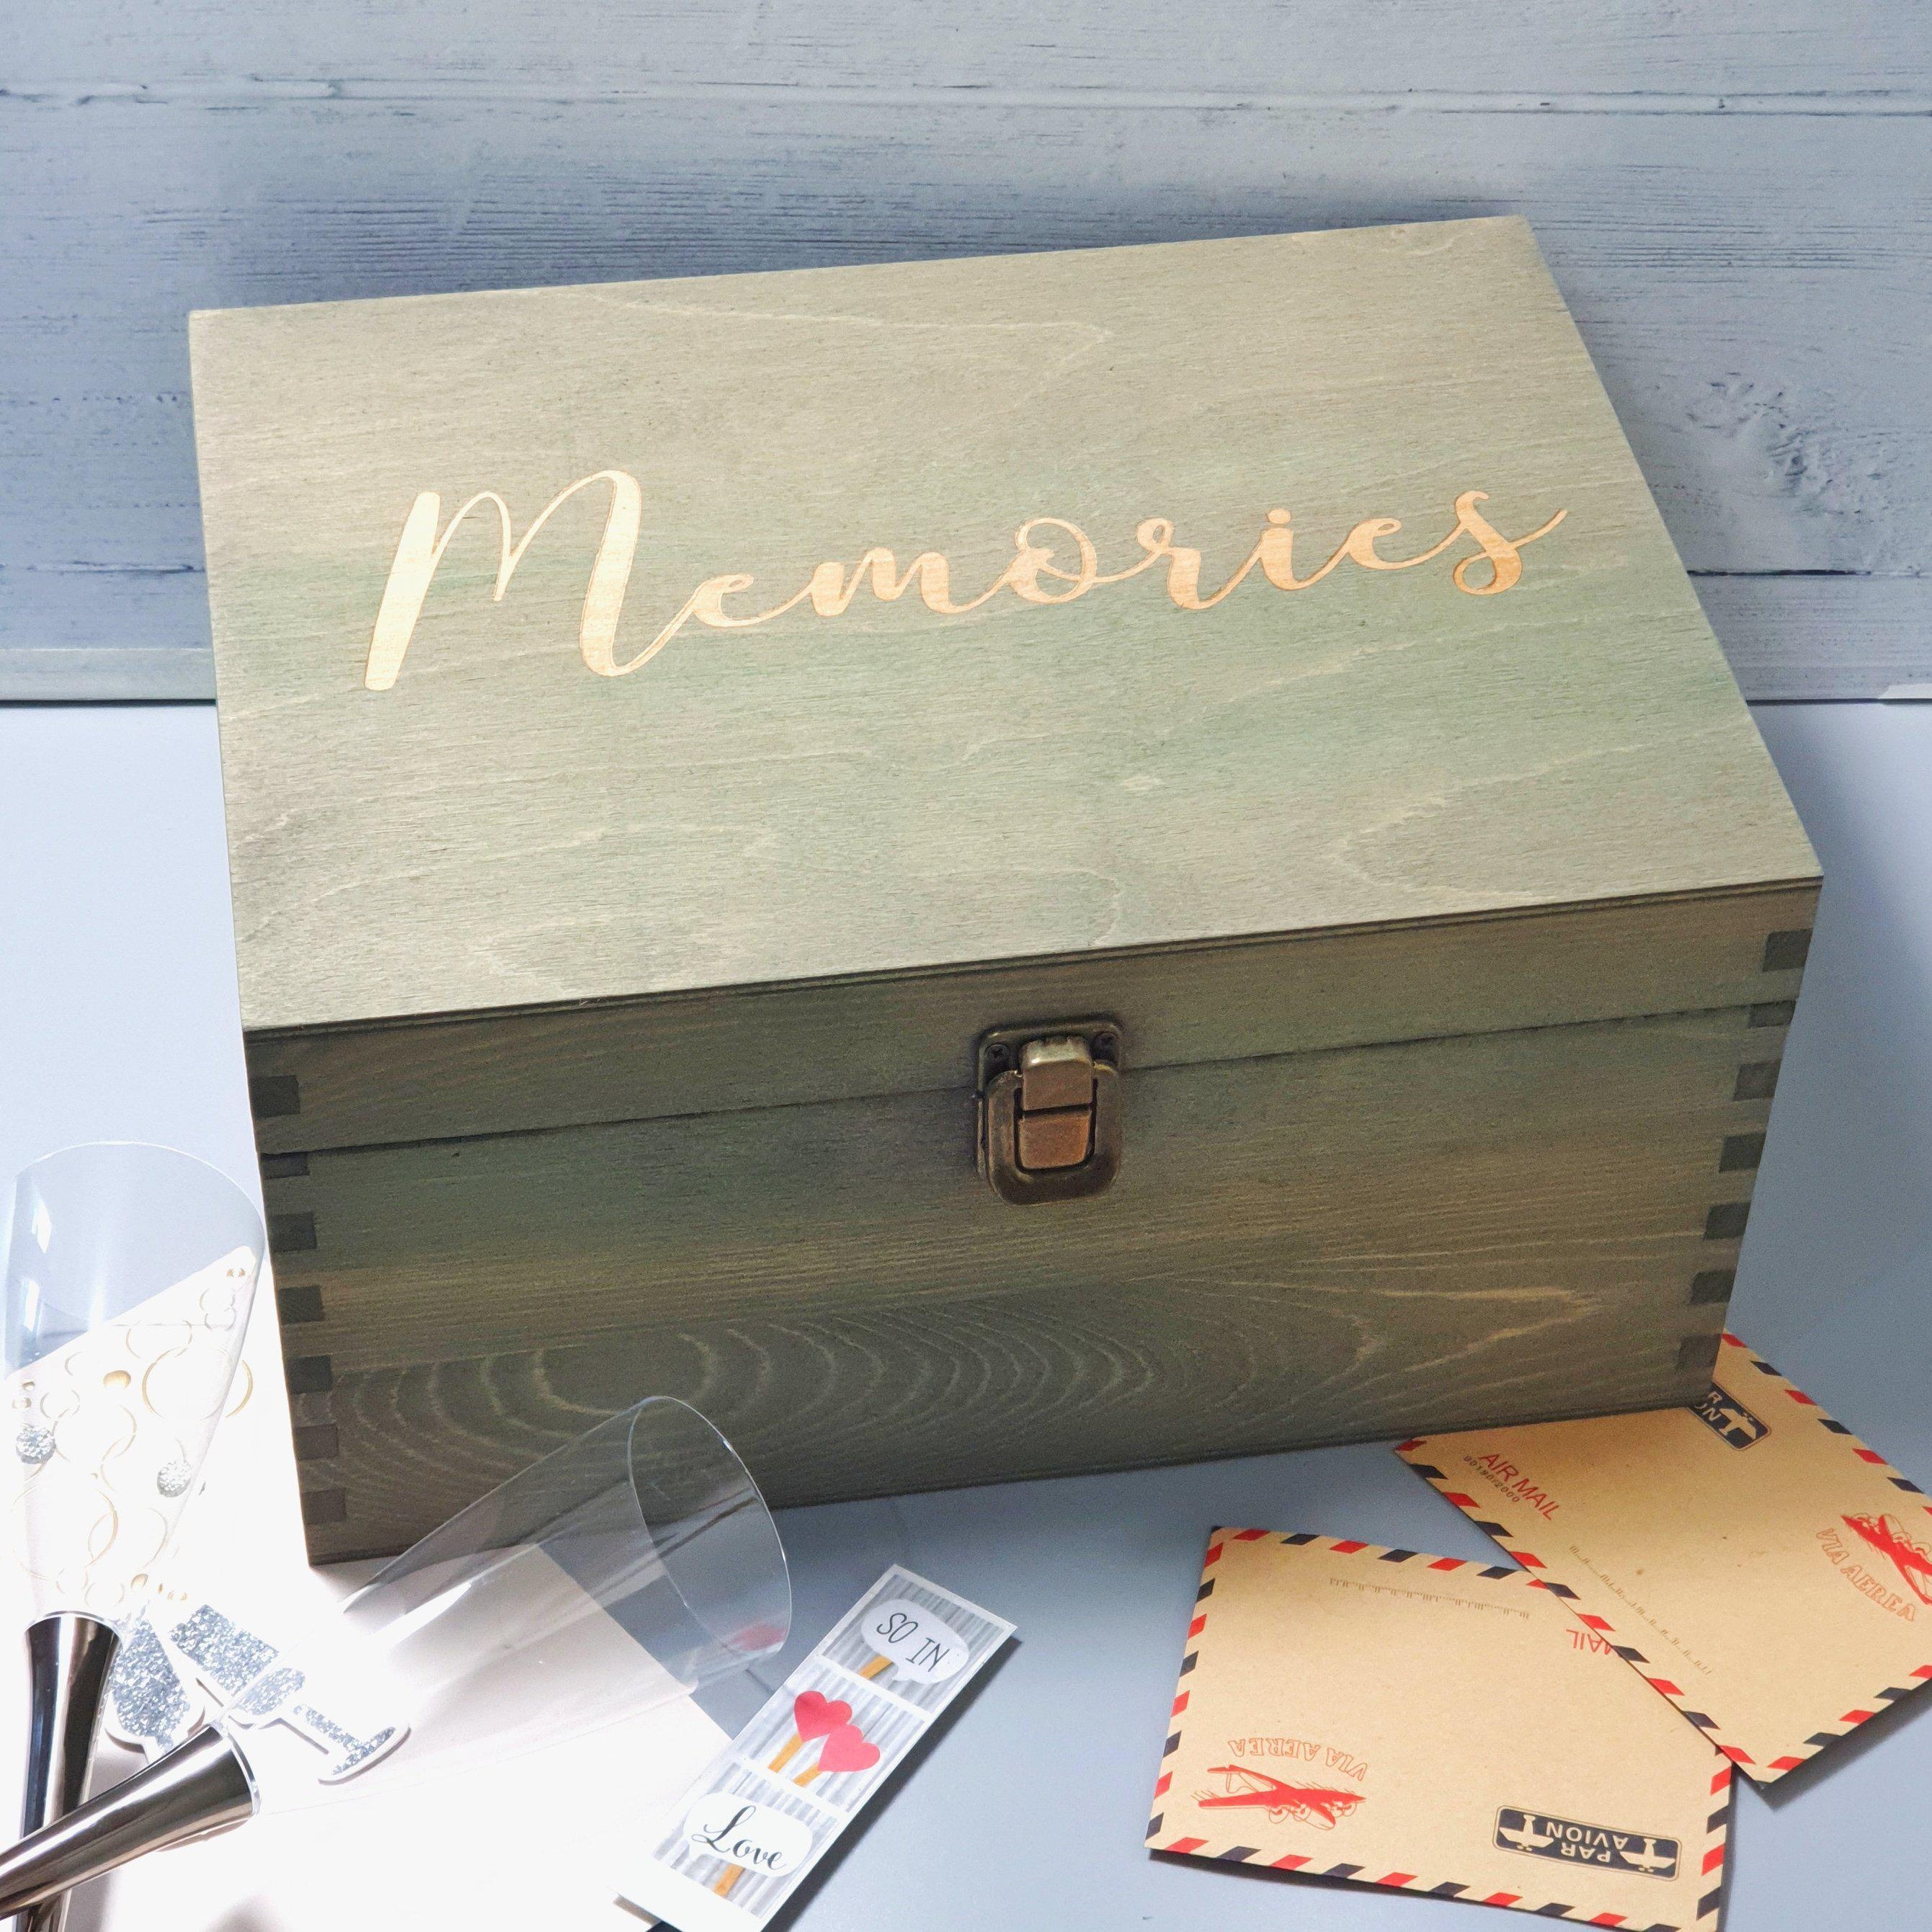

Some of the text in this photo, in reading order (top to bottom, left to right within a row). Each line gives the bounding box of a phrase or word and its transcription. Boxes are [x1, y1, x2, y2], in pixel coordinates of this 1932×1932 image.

[365, 470, 1568, 690] Memories
[1478, 1454, 1559, 1521] AIR MAIL
[1816, 1528, 1916, 1621] VIA AEREA
[876, 1613, 951, 1672] SO IN
[1228, 1737, 1368, 1781] VIA AEREA
[692, 1805, 786, 1870] Love
[1546, 1822, 1629, 1850] AVION
[1560, 1842, 1611, 1863] PAR
